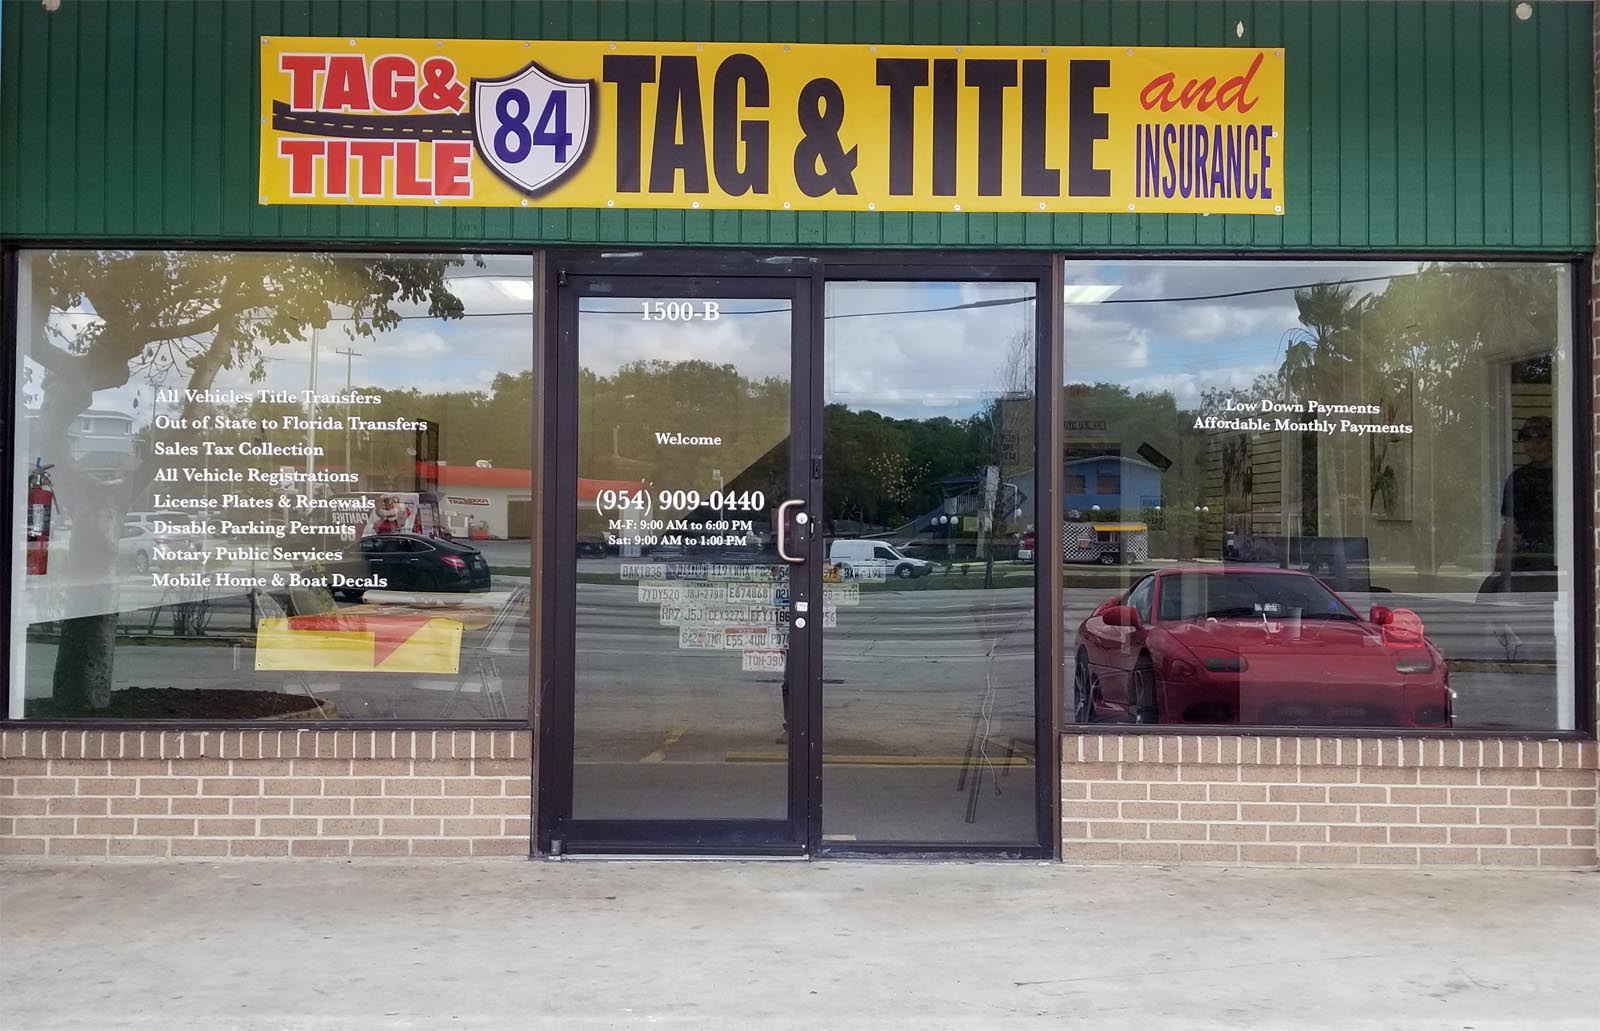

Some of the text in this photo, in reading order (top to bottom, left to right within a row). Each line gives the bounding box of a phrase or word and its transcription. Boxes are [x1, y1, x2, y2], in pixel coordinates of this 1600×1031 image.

[1140, 52, 1264, 113] and
[493, 88, 572, 164] 84
[603, 53, 1111, 198] TAG & TITLE
[279, 138, 473, 198] TITLE
[1136, 123, 1273, 200] INSURANCE
[641, 301, 720, 321] 1500-B
[155, 389, 382, 405] All Vehicles Title Transfers
[1226, 399, 1380, 417] Low Down Payments
[155, 415, 427, 431] Out of State to Florida Transfers
[1193, 416, 1413, 436] Affordable Monthly Payments
[655, 432, 722, 446] Welcome
[154, 442, 324, 457] Sales Tax Collection
[154, 468, 359, 486] All Vehicle Registrations
[153, 494, 218, 509] License
[221, 495, 275, 509] Plates
[278, 496, 291, 509] &
[295, 495, 375, 510] Renewals
[596, 489, 765, 516] (954) 909-0440
[153, 520, 356, 539] Disable Parking Permits
[609, 519, 753, 531] M-F: 9:00 AM to 6:00 PM
[608, 535, 748, 546] Sat: 9:00 AM to 1:00 PM
[152, 547, 343, 564] Notary Public Services
[152, 573, 388, 588] Mobile Home & Boat Decals
